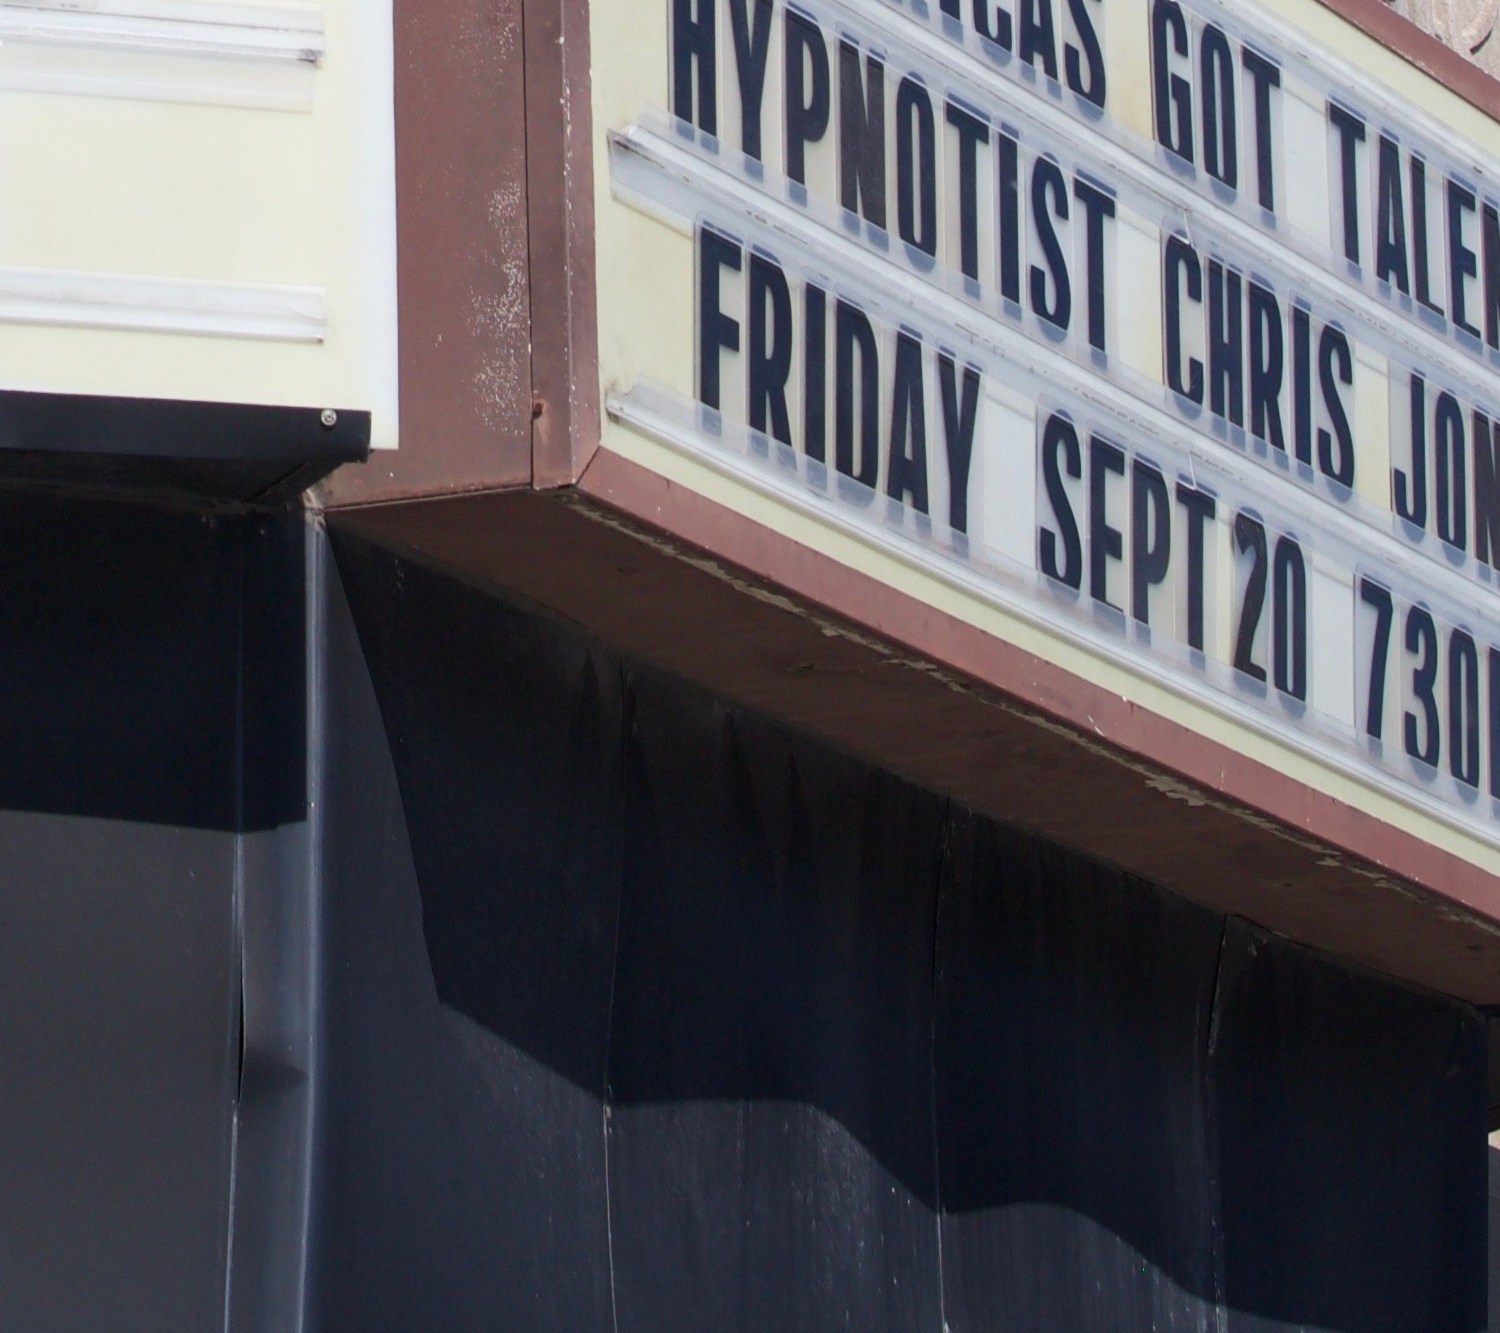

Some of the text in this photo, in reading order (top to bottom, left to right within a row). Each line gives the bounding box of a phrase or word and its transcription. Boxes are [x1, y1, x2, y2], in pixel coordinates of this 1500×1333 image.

[699, 223, 980, 535] FRIDAY
[1040, 412, 1215, 650] SEPT
[1233, 509, 1307, 703] 20
[1165, 227, 1356, 490] CHRIS
